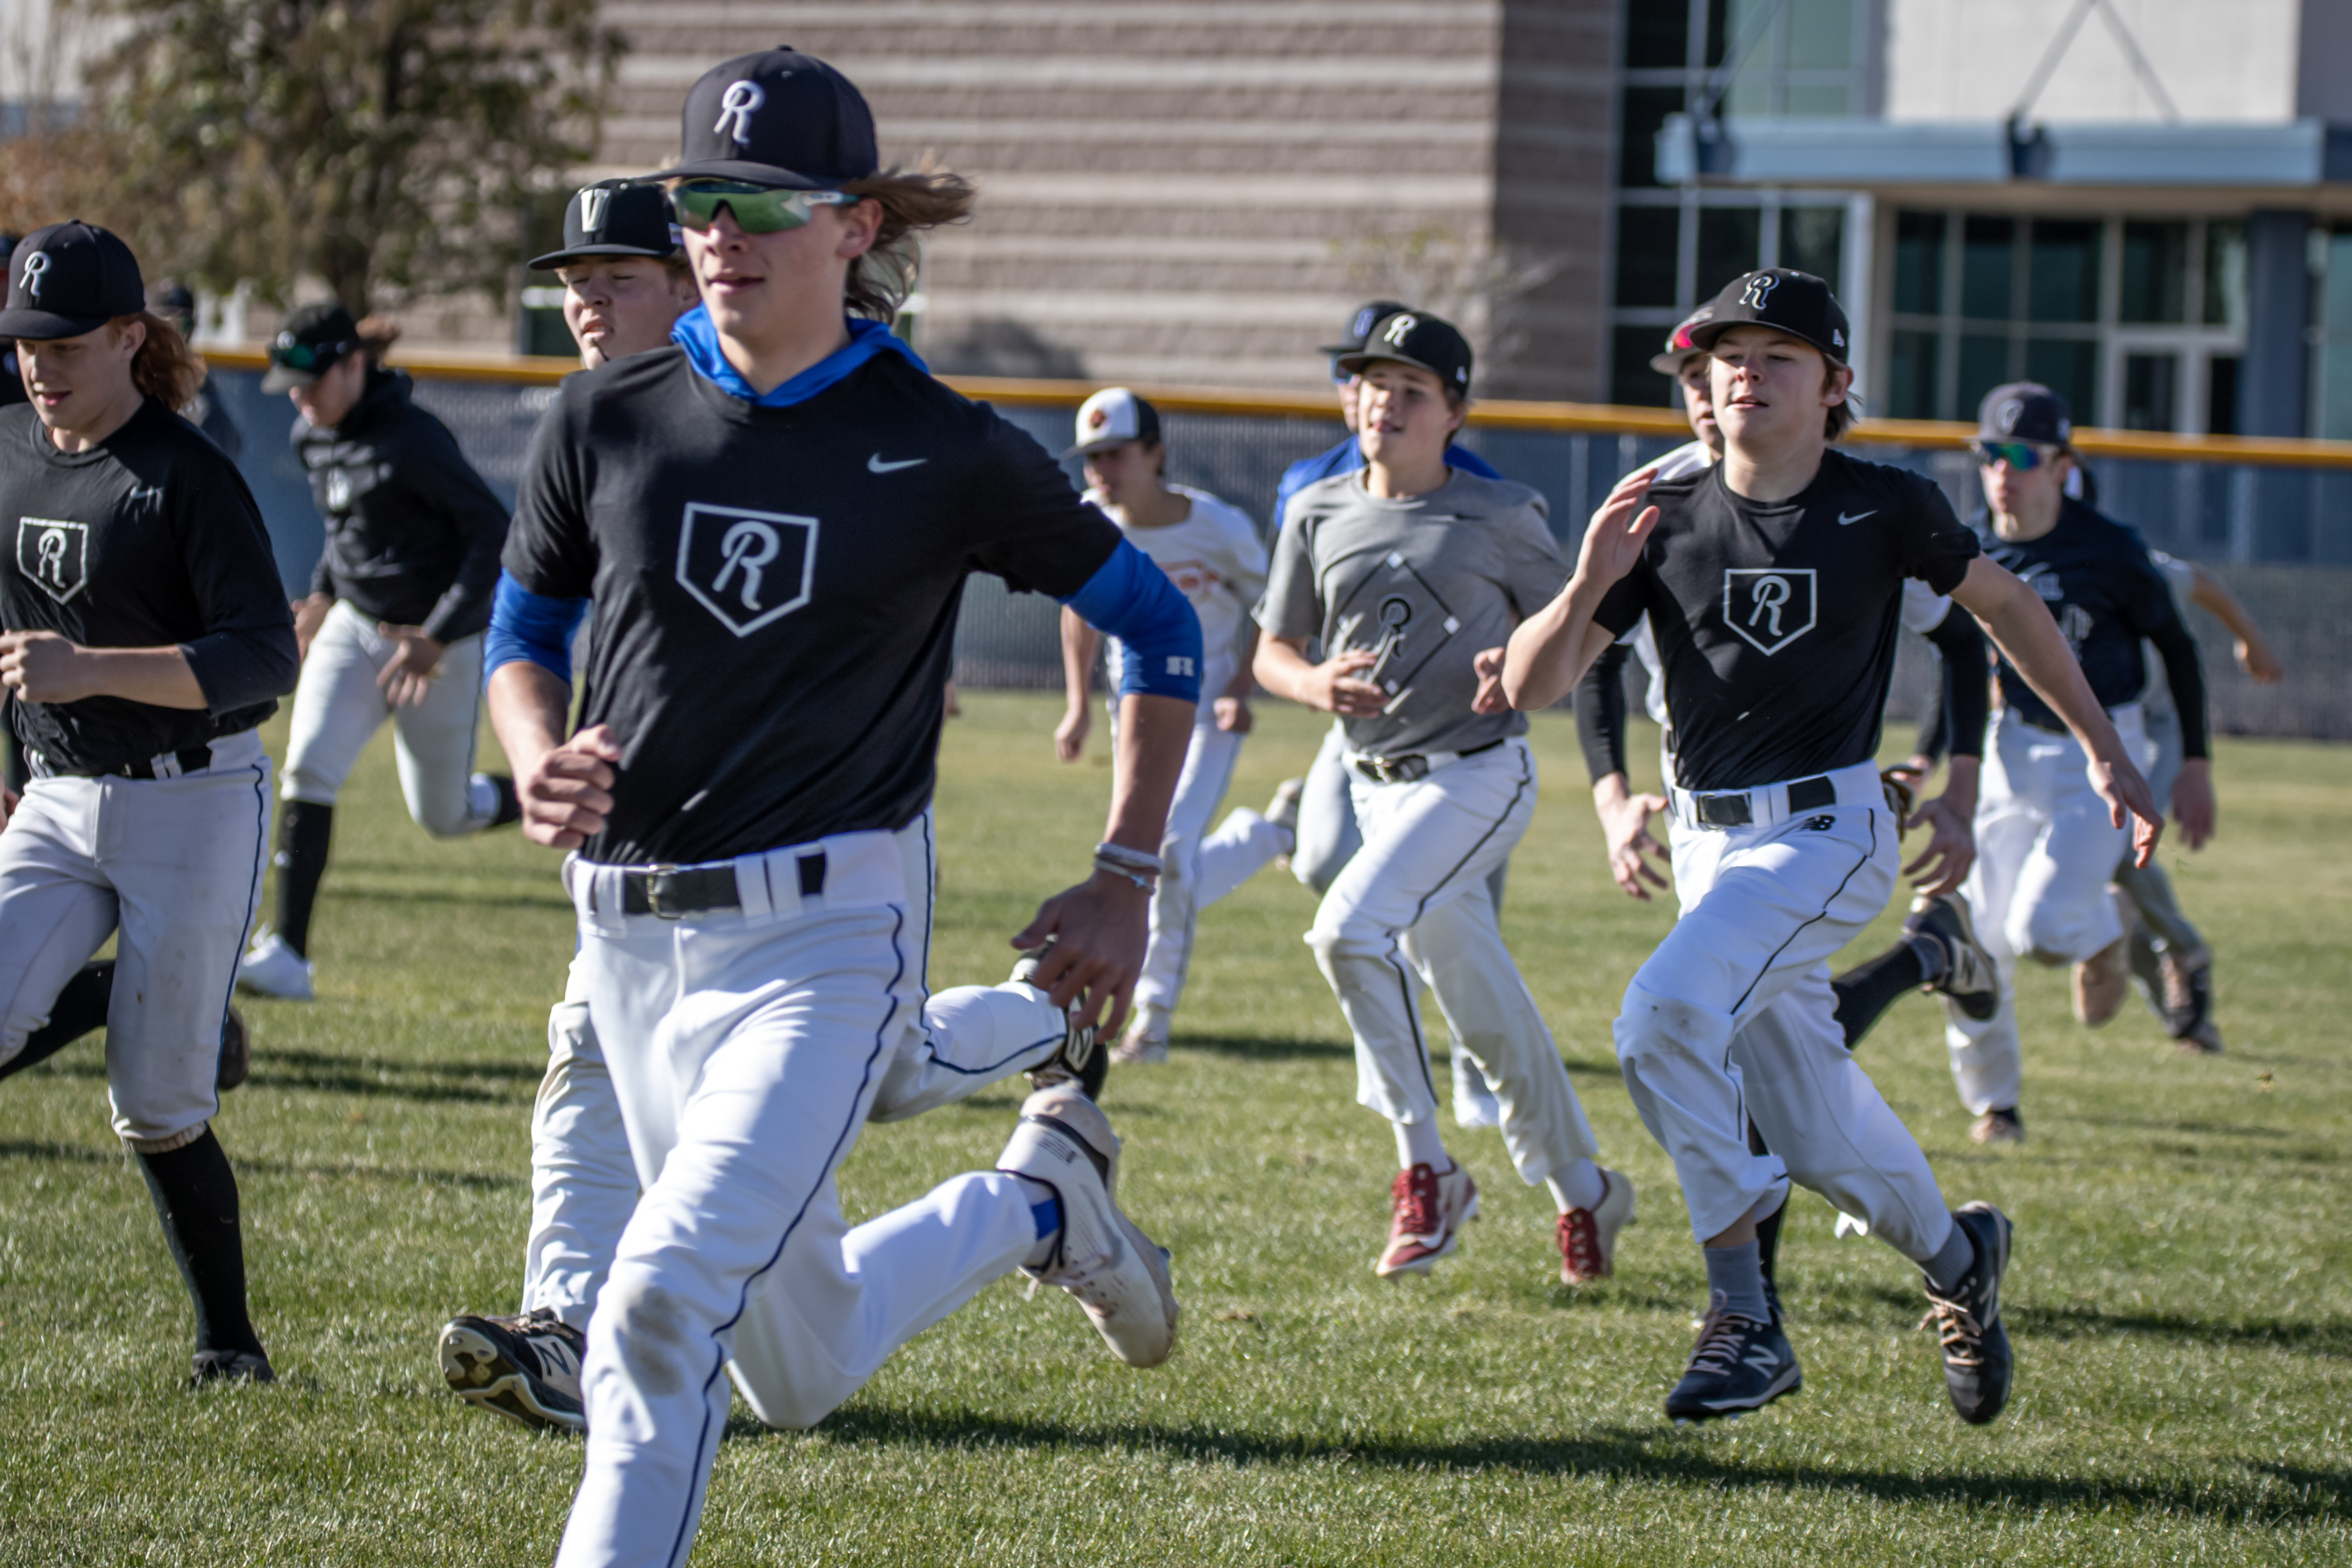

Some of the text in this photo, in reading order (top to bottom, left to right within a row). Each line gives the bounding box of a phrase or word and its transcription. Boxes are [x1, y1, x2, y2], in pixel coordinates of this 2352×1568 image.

[713, 80, 766, 145] R
[580, 189, 611, 233] V
[19, 251, 51, 297] R
[1738, 273, 1779, 310] R
[1383, 314, 1417, 348] R
[38, 528, 67, 588] R
[712, 520, 781, 610] R
[1748, 575, 1791, 637] R
